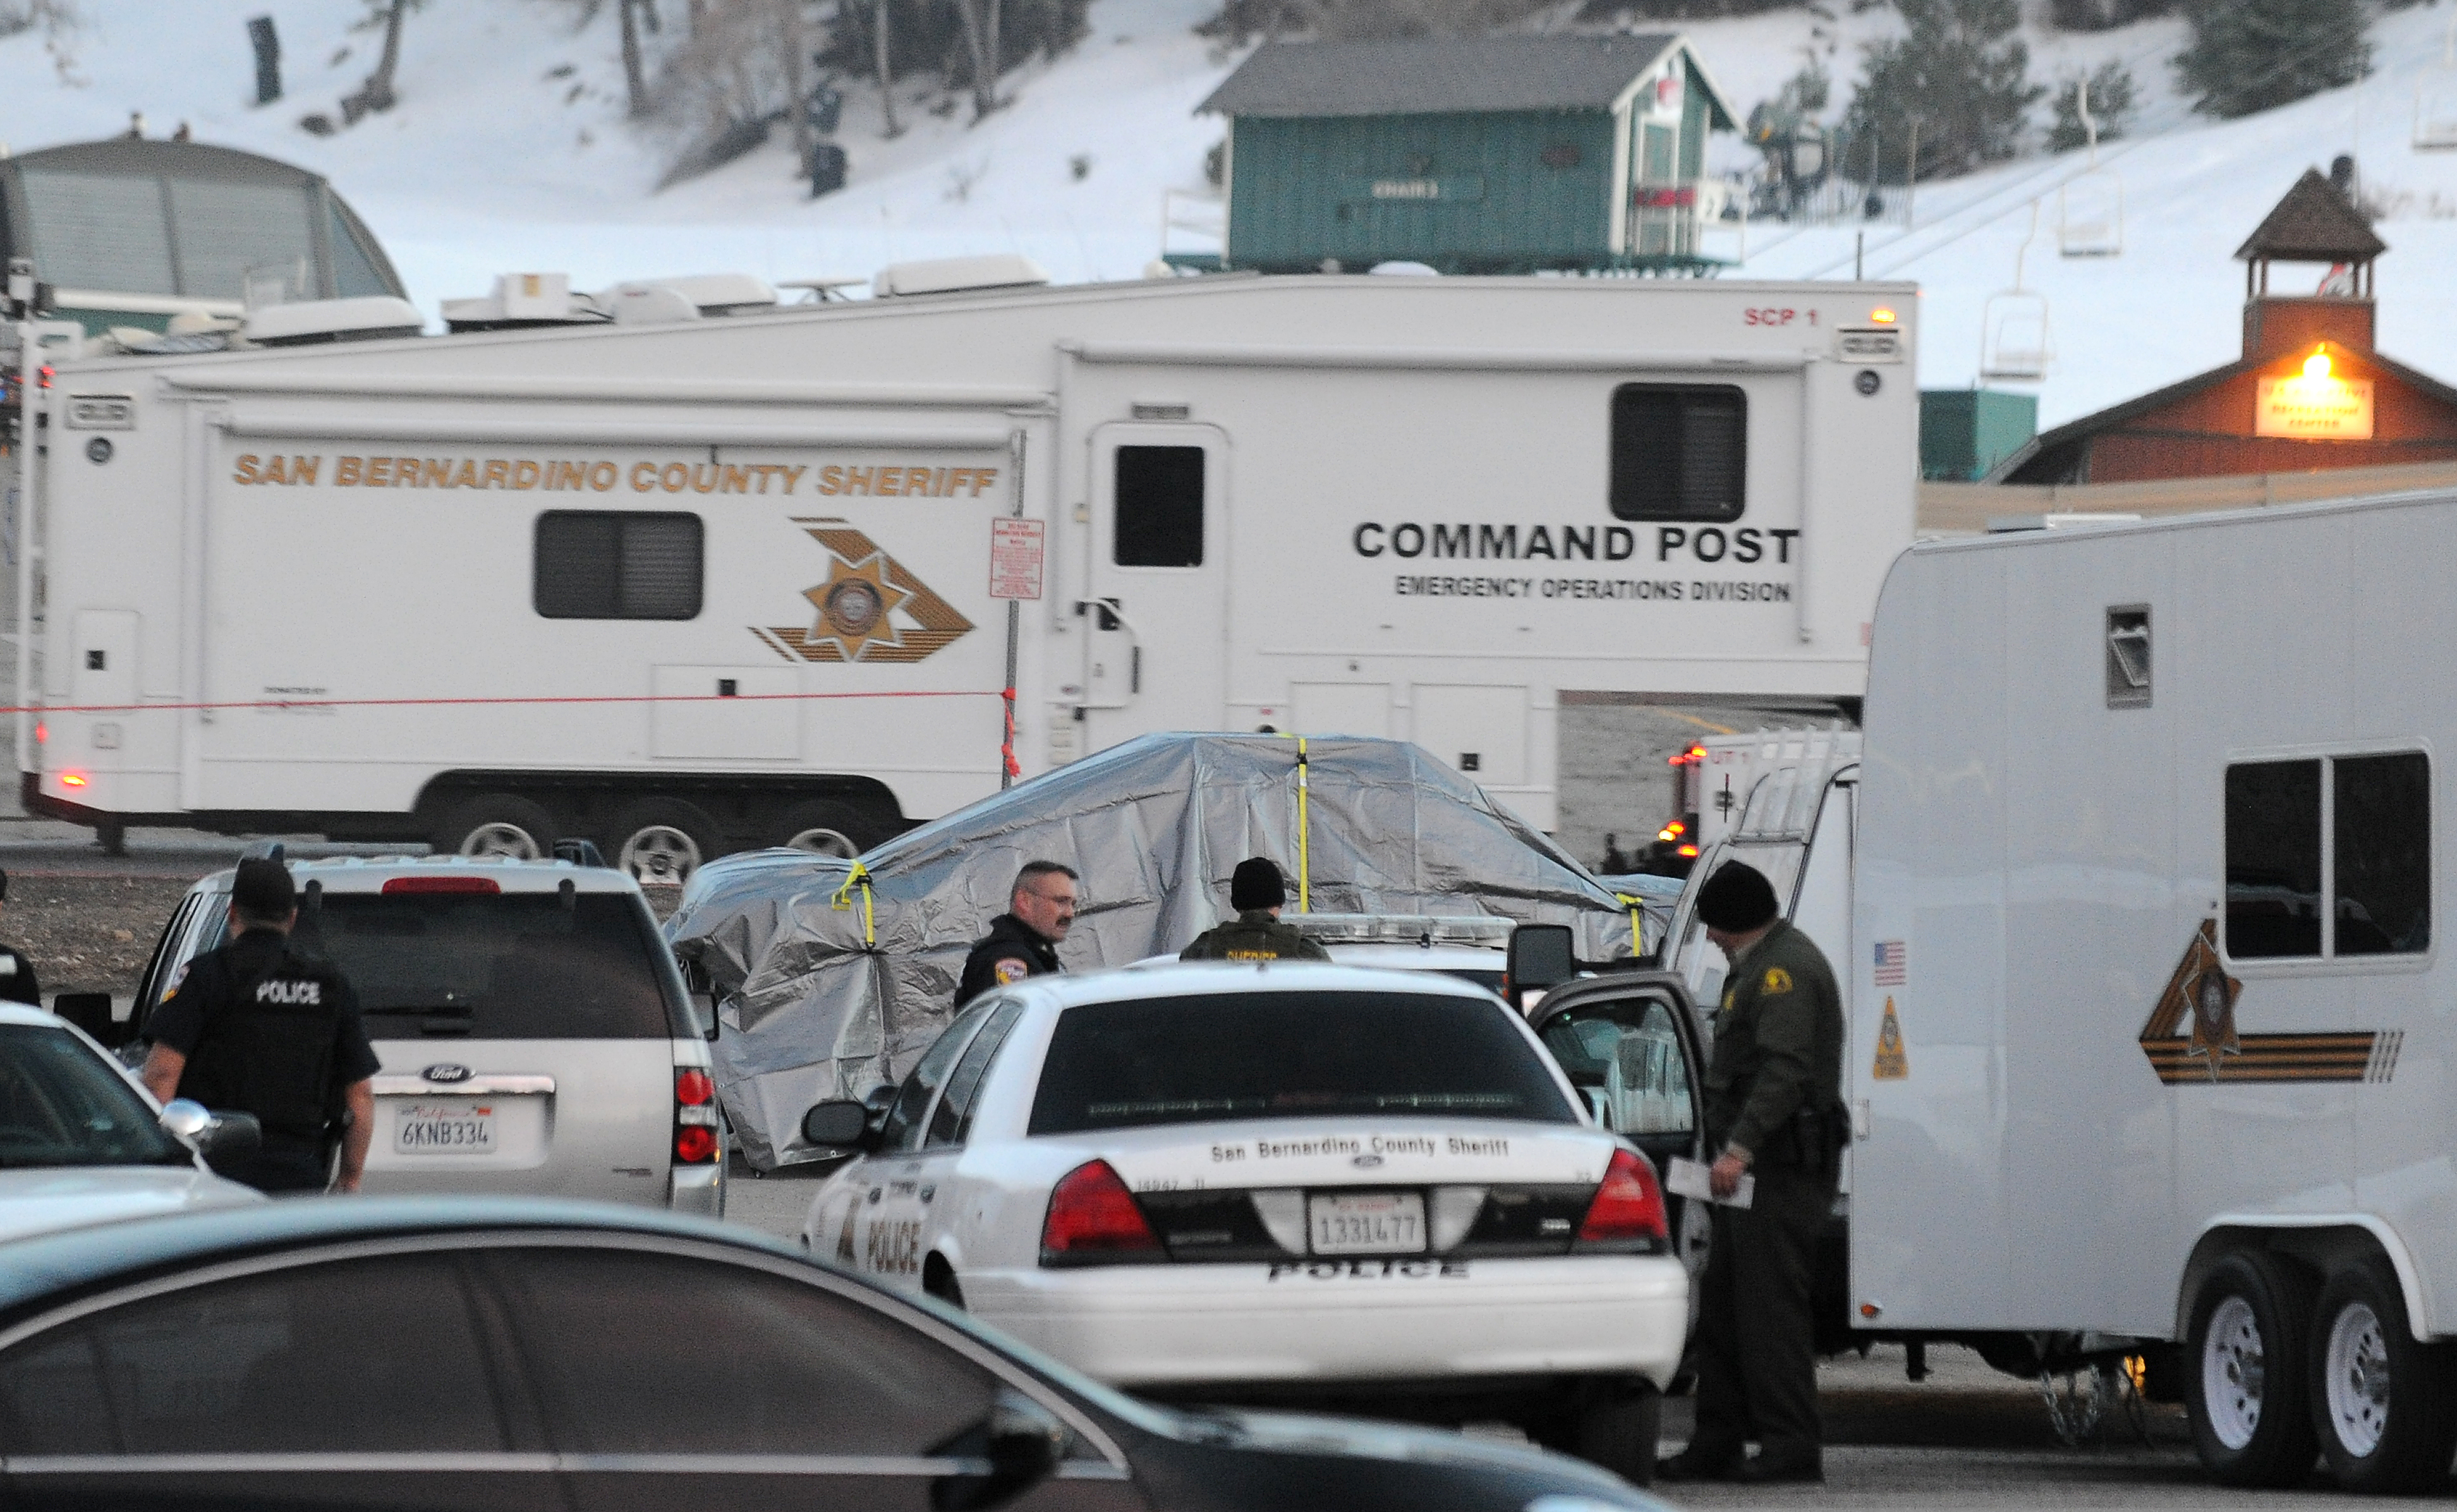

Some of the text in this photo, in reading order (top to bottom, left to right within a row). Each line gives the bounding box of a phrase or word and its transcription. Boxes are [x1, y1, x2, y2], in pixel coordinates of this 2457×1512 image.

[1745, 308, 1795, 326] SCP
[233, 455, 998, 497] SAN BERNARDINO COUNTY SHERIFF
[1354, 523, 1800, 563] COMMAND POST
[1396, 576, 1791, 602] EMERGENCY OPERATIONS DIVISION
[256, 980, 320, 1005] POLICE
[403, 1122, 488, 1144] 6KNB334
[1211, 1137, 1508, 1163] San Bernardino County Sheriff
[868, 1221, 920, 1273] POLICE
[1268, 1262, 1471, 1283] POLICE
